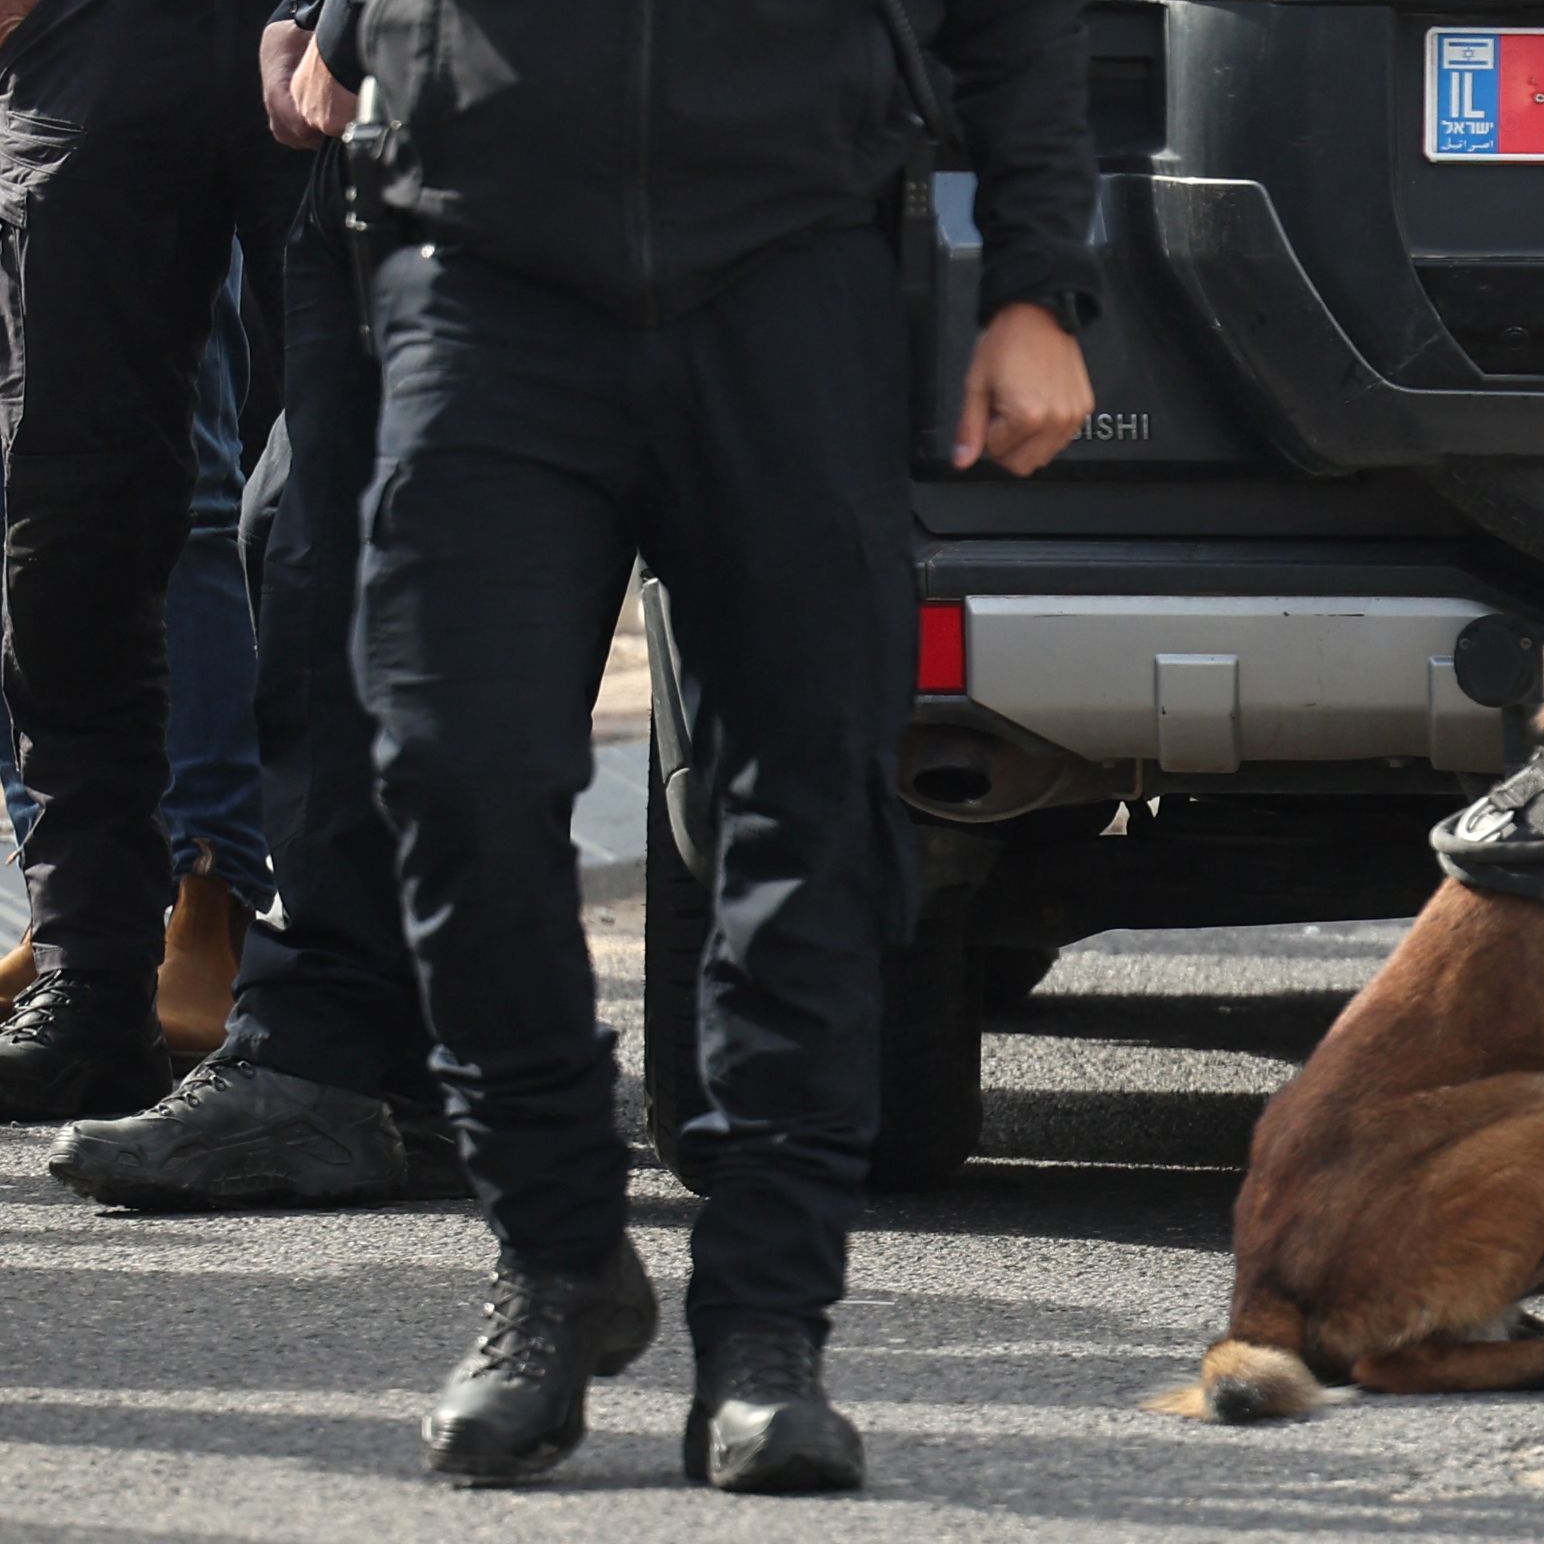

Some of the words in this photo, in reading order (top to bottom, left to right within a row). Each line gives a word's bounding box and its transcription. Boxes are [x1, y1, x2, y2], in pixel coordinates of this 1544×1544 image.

[1451, 71, 1485, 118] IL
[1441, 120, 1494, 135] ישראל
[1072, 413, 1149, 440] ISHI
